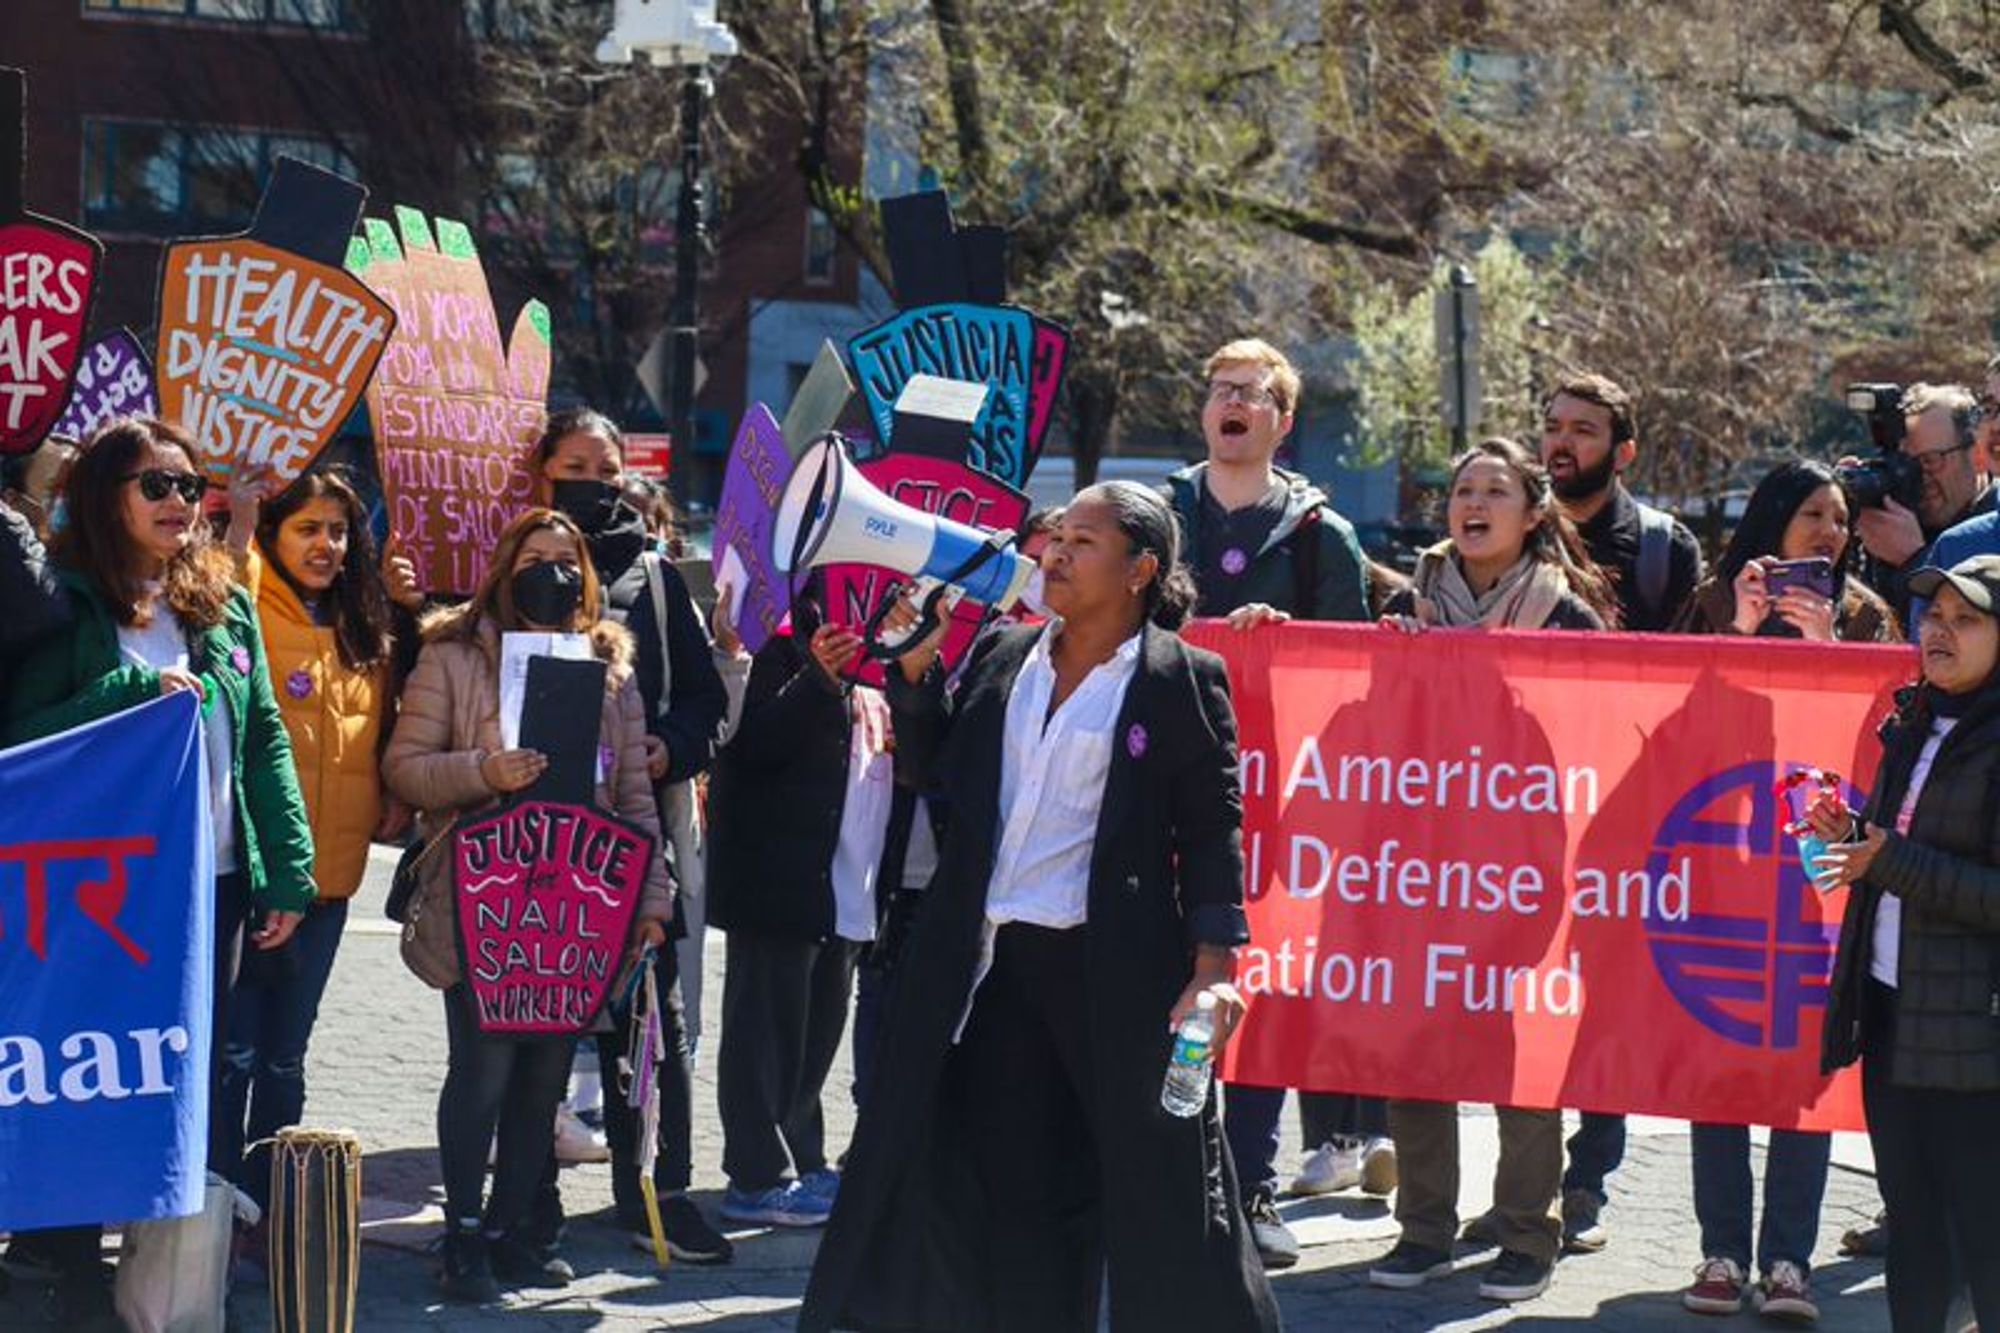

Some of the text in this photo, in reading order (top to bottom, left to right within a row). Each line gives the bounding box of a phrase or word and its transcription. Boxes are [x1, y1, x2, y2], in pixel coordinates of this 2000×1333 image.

[0, 253, 87, 314] ERS
[185, 252, 385, 385] HEALTH
[166, 329, 345, 429] DIGNITY
[859, 311, 1025, 403] JUSTICIA
[385, 447, 533, 498] MINIMOS
[396, 494, 433, 542] DE
[1282, 735, 1599, 816] American
[461, 807, 635, 890] JUSTICE
[524, 866, 561, 896] for
[1287, 833, 1544, 915] Defense
[1570, 857, 1691, 922] and
[476, 897, 600, 938] NAIL
[475, 936, 610, 982] SALON
[1236, 935, 1581, 1017] ation Fund
[476, 983, 593, 1027] WORKERS
